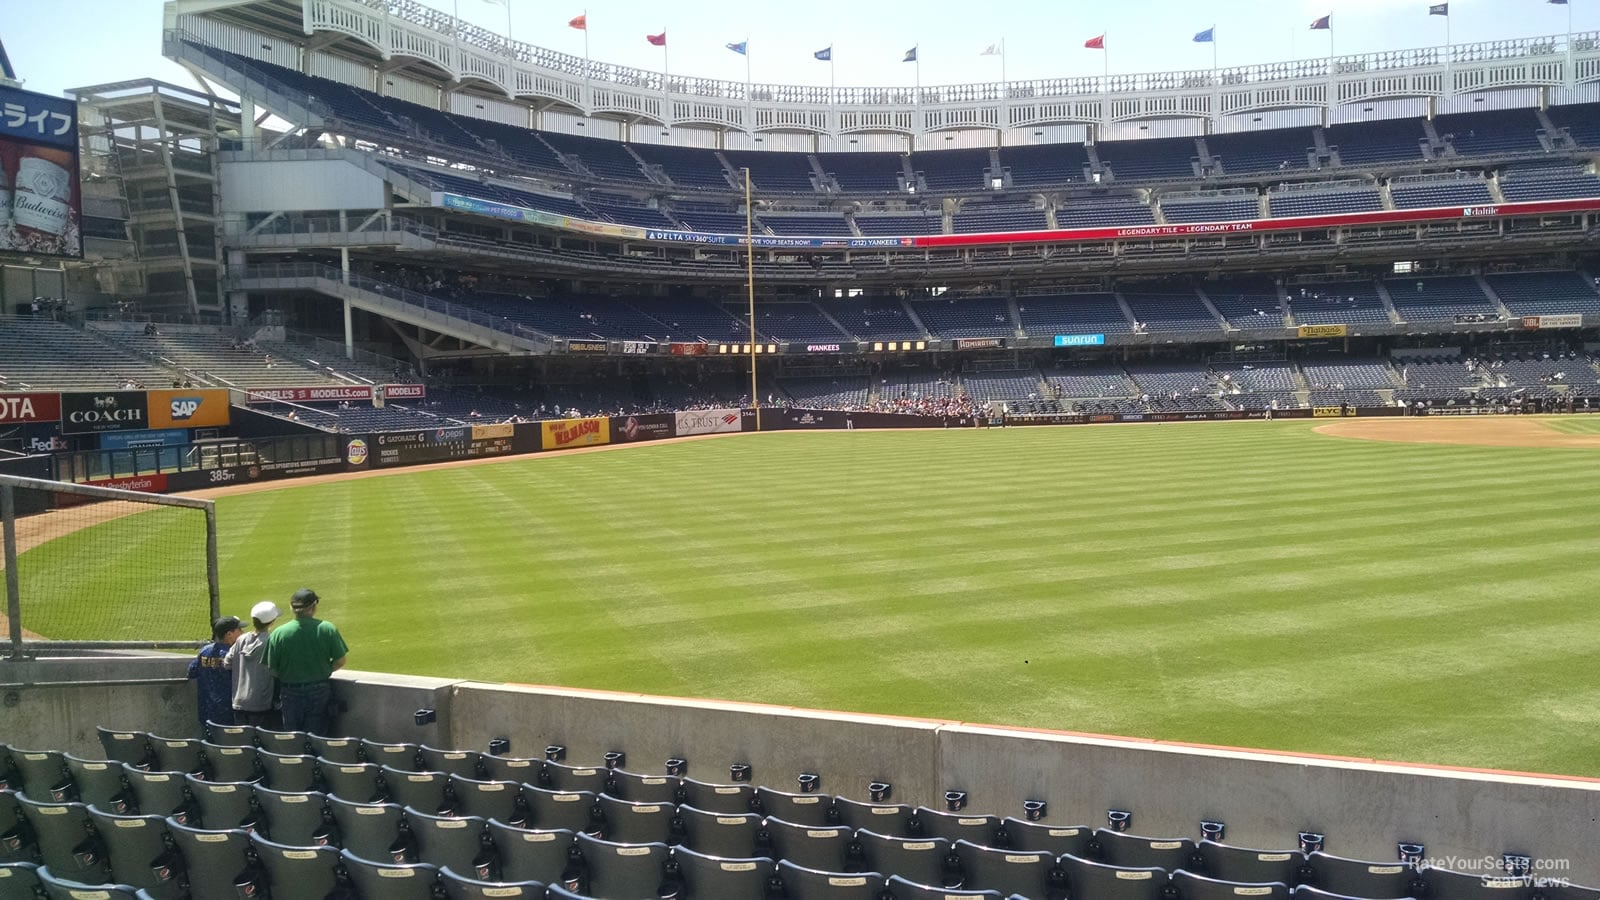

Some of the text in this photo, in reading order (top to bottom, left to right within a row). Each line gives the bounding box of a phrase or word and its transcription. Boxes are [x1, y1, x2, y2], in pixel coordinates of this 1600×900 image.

[0, 103, 71, 135] ライフ
[1472, 207, 1497, 216] daltile
[657, 232, 683, 241] DELTA
[1118, 228, 1160, 236] LEGENDARY
[851, 239, 867, 247] (212)
[1062, 335, 1097, 344] sunrun
[807, 344, 840, 352] @YANKEES
[250, 390, 294, 400] MODELL'S
[310, 389, 369, 399] MODELLS.com
[388, 387, 421, 396] MODELL'S
[171, 401, 197, 417] SAP
[69, 408, 141, 423] COACH
[692, 416, 719, 428] TRUST
[31, 436, 68, 451] FedEx
